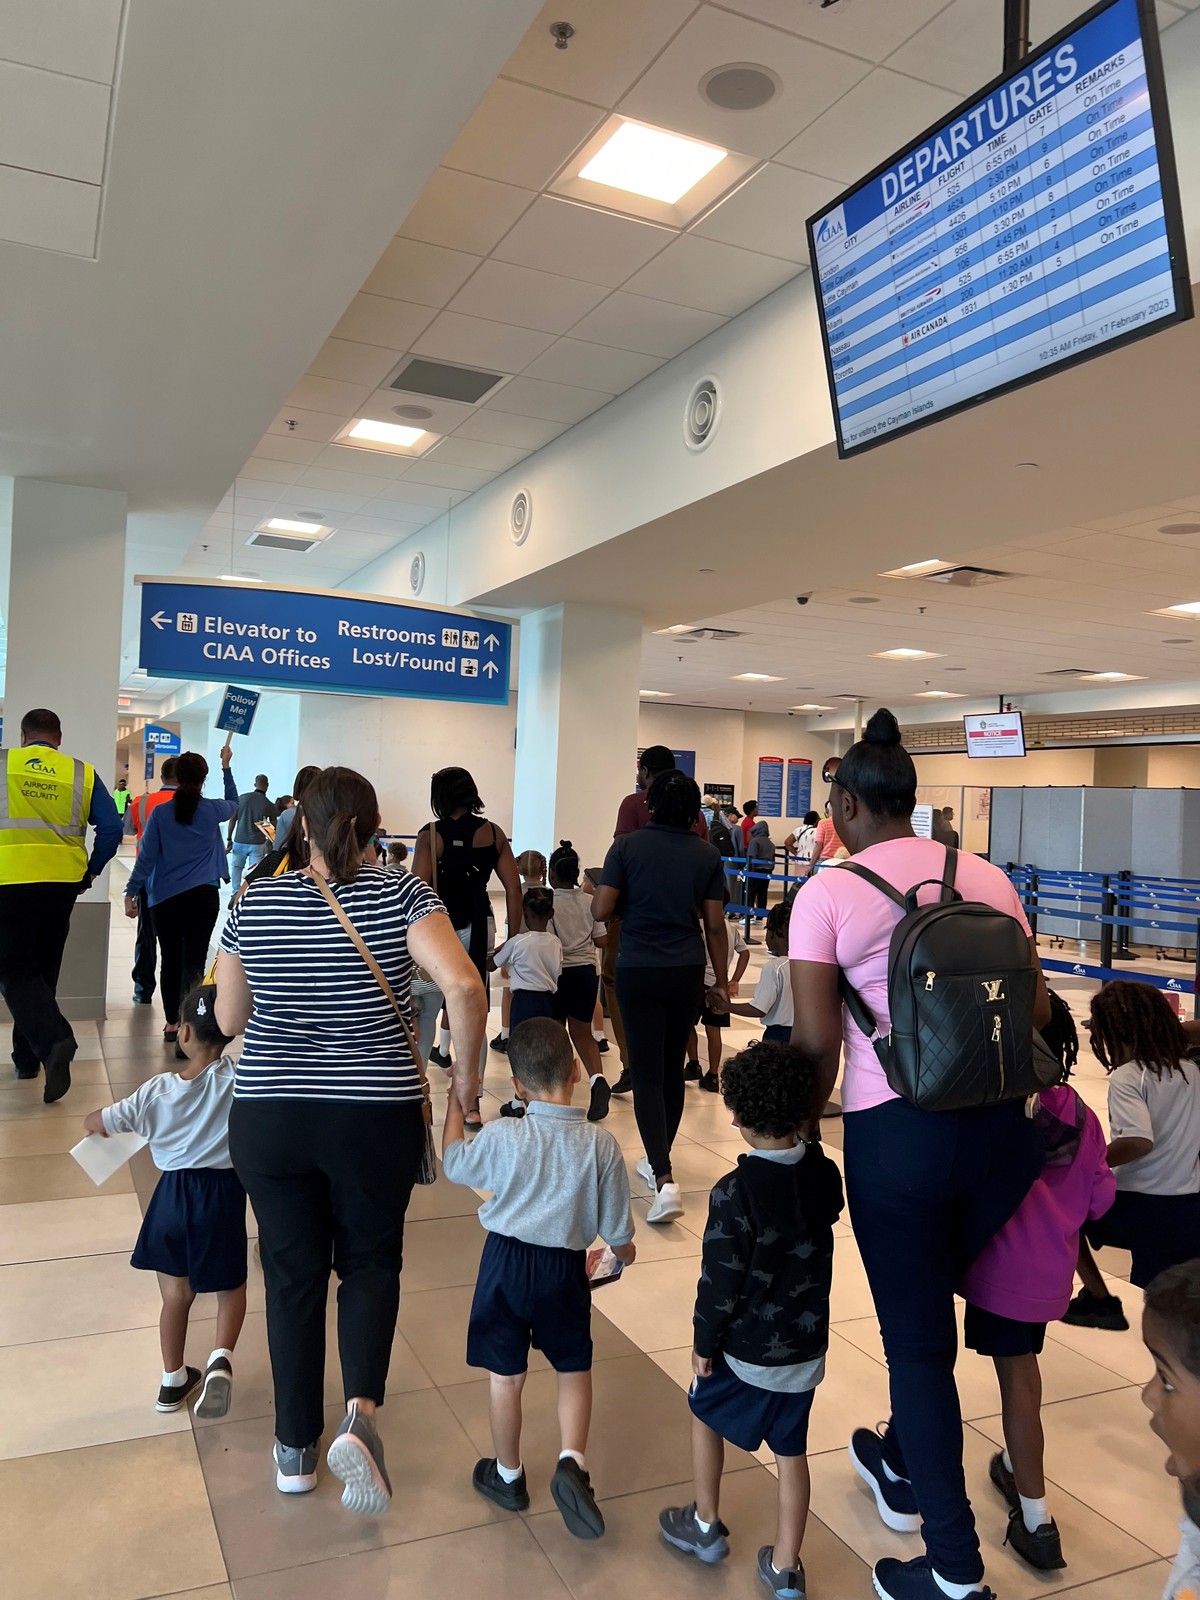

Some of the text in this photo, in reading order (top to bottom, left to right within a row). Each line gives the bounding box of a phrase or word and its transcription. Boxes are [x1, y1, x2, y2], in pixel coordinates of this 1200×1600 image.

[844, 235, 858, 250] CITY
[894, 192, 921, 216] AIRLINE
[938, 161, 966, 186] FLIGHT
[987, 133, 1007, 152] TIME
[1028, 102, 1053, 125] GATE
[1075, 54, 1125, 94] REMARKS
[881, 43, 1078, 207] DEPARTURES
[988, 171, 1004, 188] 2:30
[1005, 161, 1019, 175] PM
[1041, 143, 1048, 153] 9
[1086, 110, 1100, 125] On
[1101, 95, 1124, 114] Time
[820, 264, 840, 281] London
[947, 183, 960, 198] 525
[986, 154, 1002, 172] 6:55
[1003, 144, 1017, 159] PM
[1039, 126, 1045, 136] 7
[1083, 93, 1098, 108] On
[1099, 79, 1121, 97] Time
[836, 280, 859, 298] Cayman
[949, 211, 967, 227] 4426
[990, 186, 1006, 203] 5:10
[1007, 176, 1021, 190] PM
[1044, 159, 1050, 169] 6
[1088, 128, 1102, 142] On
[1103, 113, 1126, 131] Time
[954, 243, 968, 257] 956
[994, 217, 1010, 234] 3:30
[1011, 208, 1025, 223] PM
[1048, 191, 1054, 202] 8
[1092, 162, 1106, 176] On
[1108, 148, 1130, 166] Time
[992, 202, 1008, 218] 1:10
[1009, 193, 1023, 207] PM
[1090, 145, 1104, 159] On
[1105, 131, 1128, 149] Time
[821, 221, 843, 243] CIAA
[995, 233, 1012, 249] 4:45
[1013, 224, 1027, 238] PM
[1050, 208, 1056, 219] 2
[1094, 179, 1108, 193] On
[1110, 165, 1133, 183] Time
[831, 341, 850, 356] Nassau
[958, 272, 972, 287] 525
[997, 248, 1014, 265] 6:55
[1015, 240, 1029, 254] PM
[1052, 224, 1058, 235] 7
[1096, 196, 1110, 210] On
[1112, 183, 1135, 201] Time
[961, 288, 974, 302] 200
[999, 262, 1018, 280] 11:20
[1019, 255, 1033, 269] AM
[1054, 240, 1060, 250] 4
[1098, 213, 1112, 227] On
[1114, 200, 1137, 218] Time
[834, 366, 854, 381] Toronto
[910, 330, 921, 341] AIR
[921, 316, 948, 335] CANADA
[961, 302, 978, 316] 1831
[1002, 279, 1018, 295] 1:30
[1019, 271, 1033, 285] PM
[1056, 257, 1062, 267] 5
[1100, 230, 1114, 244] On
[1116, 217, 1139, 236] Time
[1039, 298, 1170, 361] 10:35 AM Friday, 17 February 2023
[850, 431, 858, 441] for
[858, 425, 877, 439] visiting
[877, 421, 886, 430] the
[887, 410, 911, 429] Cayman
[912, 400, 934, 415] Islands
[202, 641, 331, 670] CIAA Offices
[203, 616, 317, 644] Elevator to
[338, 620, 436, 646] Restrooms
[352, 648, 456, 673] Lost/Found
[225, 692, 256, 707] Follow
[229, 704, 247, 716] Me!
[21, 789, 59, 801] SECURITY
[23, 780, 58, 791] AIRPORT
[31, 762, 57, 774] CIAA
